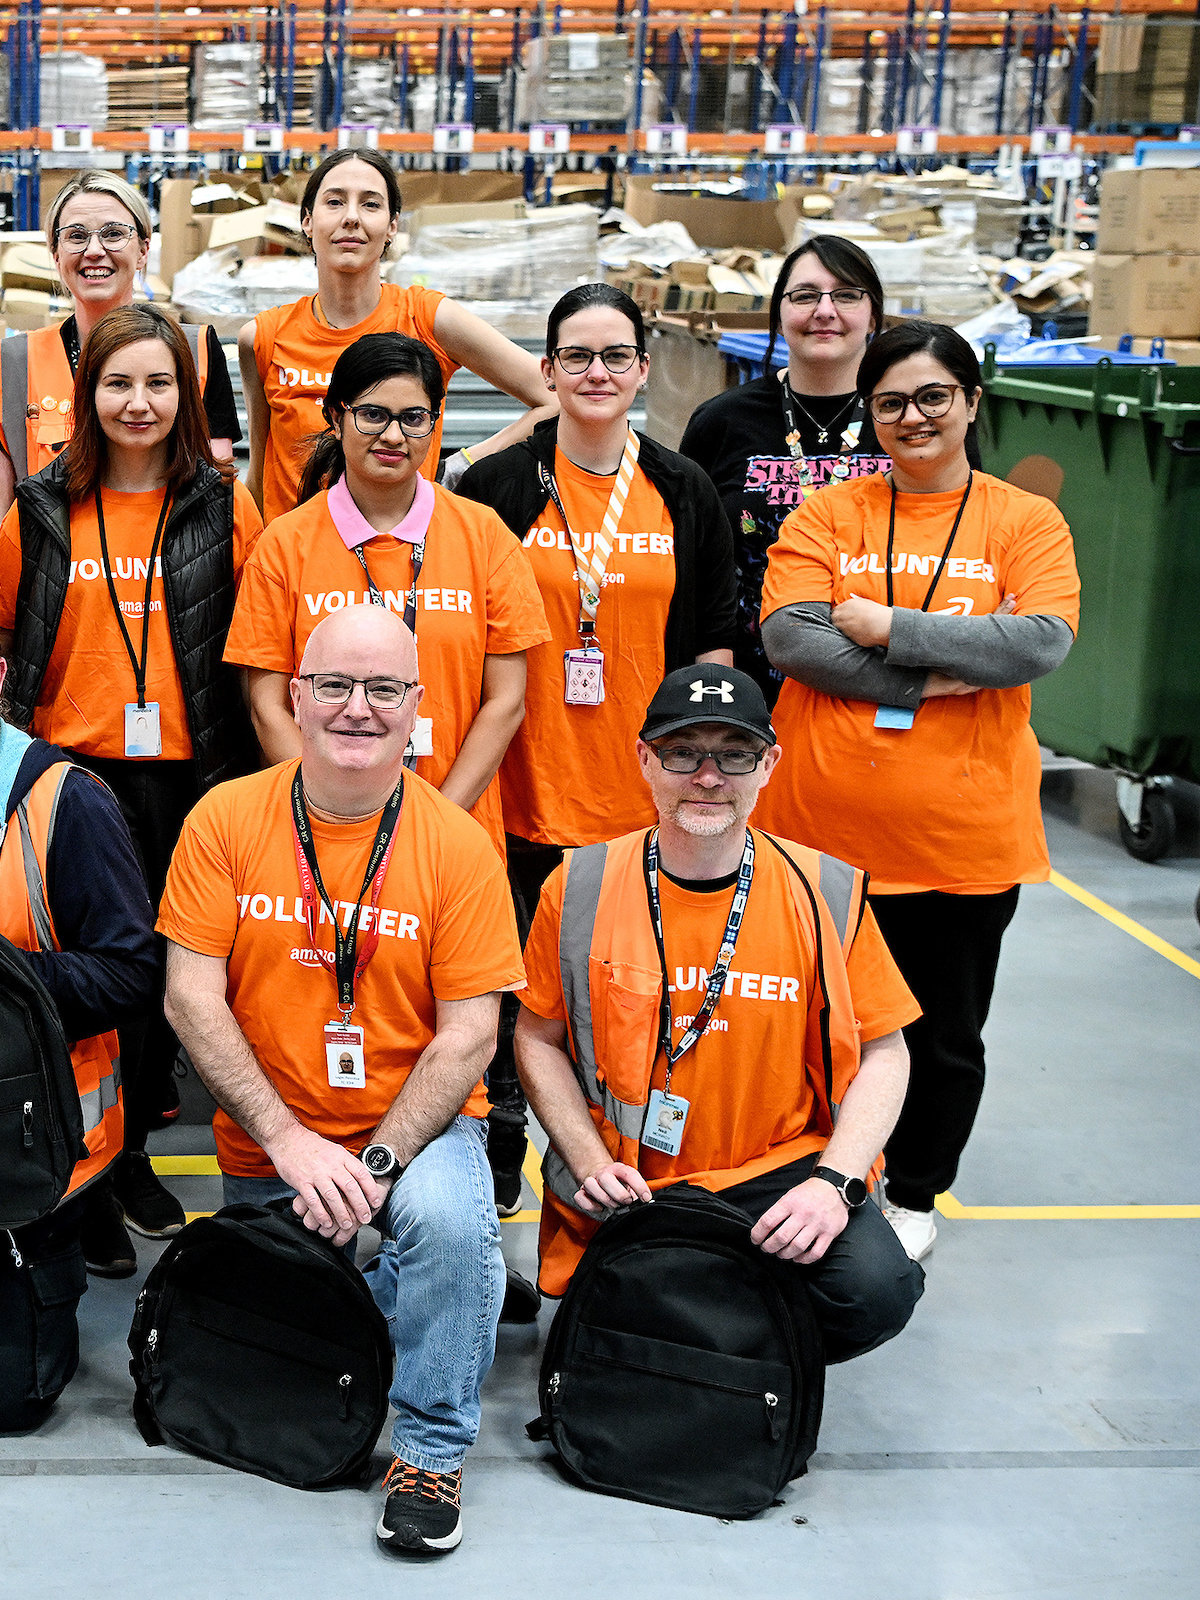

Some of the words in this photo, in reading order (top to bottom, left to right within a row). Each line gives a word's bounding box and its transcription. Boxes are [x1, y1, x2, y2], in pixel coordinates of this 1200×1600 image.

[572, 571, 625, 584] azon
[119, 600, 162, 612] amaon
[294, 799, 309, 830] Customer
[300, 830, 310, 842] CR
[380, 832, 390, 844] CR
[668, 966, 800, 1003] UNTEER
